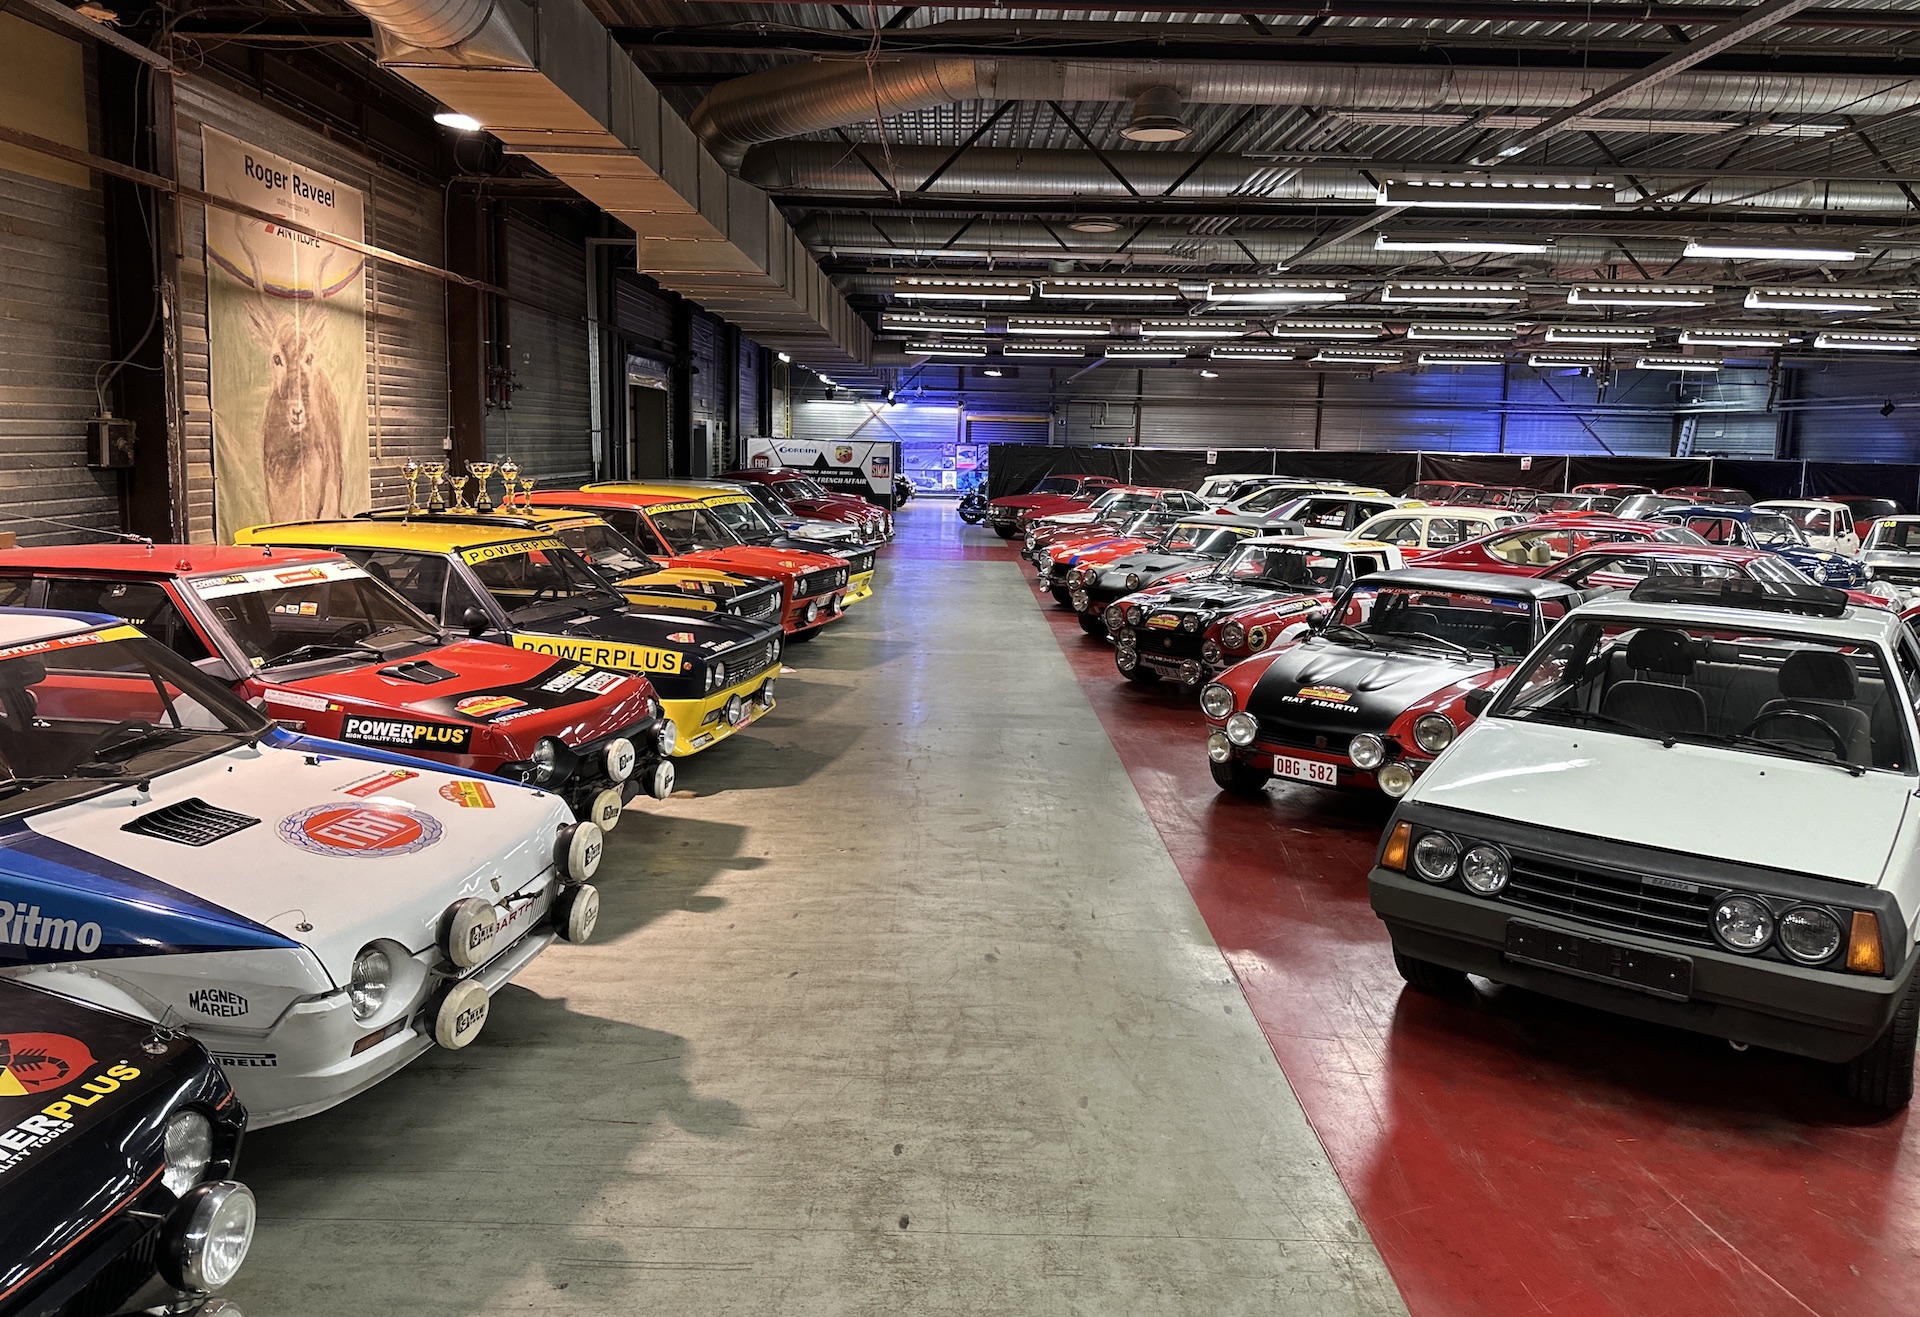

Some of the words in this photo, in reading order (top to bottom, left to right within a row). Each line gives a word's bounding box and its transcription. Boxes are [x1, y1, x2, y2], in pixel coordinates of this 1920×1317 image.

[245, 154, 288, 190] Roger
[293, 174, 335, 208] Raveel
[755, 458, 769, 468] FIAT
[872, 464, 890, 478] SIMCA
[1282, 696, 1306, 704] FIAT
[1311, 700, 1359, 713] ABARTH
[347, 719, 465, 744] POWERPLUS
[315, 811, 407, 847] FIAT
[1651, 879, 1689, 891] SAMARA
[0, 902, 103, 953] Ritmo
[495, 901, 536, 933] BARTH
[189, 989, 248, 1007] MAGNETI
[189, 1002, 249, 1017] MARELLI
[0, 1065, 141, 1161] ERPLUS
[30, 1122, 75, 1148] TOOLS
